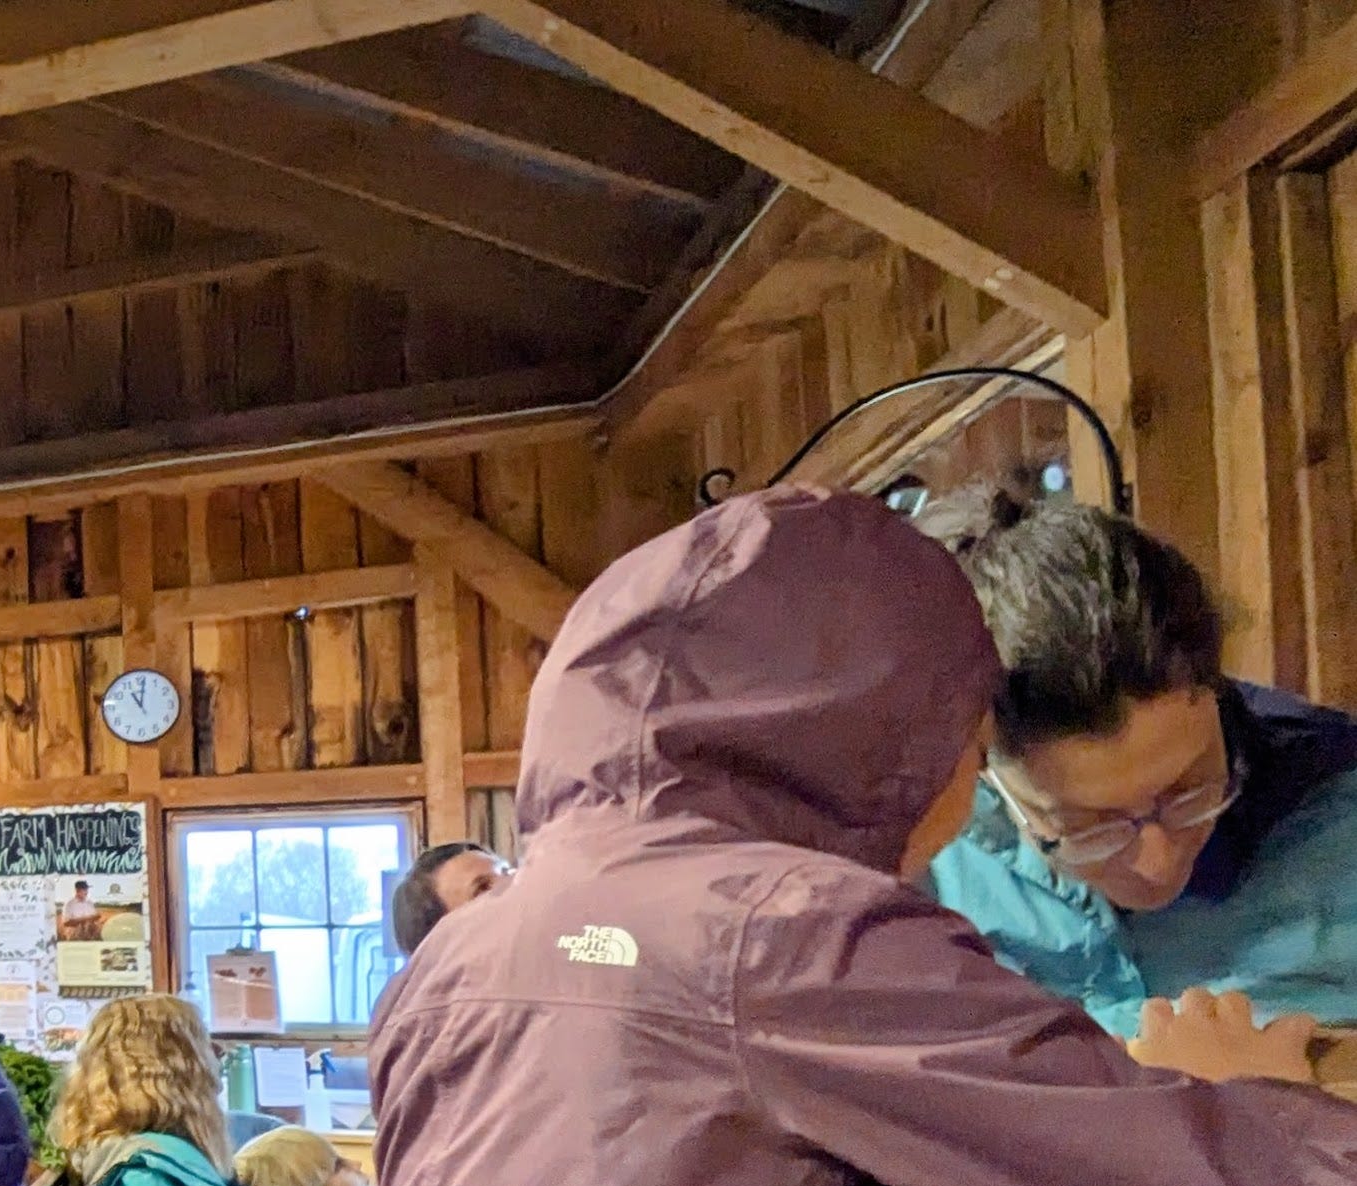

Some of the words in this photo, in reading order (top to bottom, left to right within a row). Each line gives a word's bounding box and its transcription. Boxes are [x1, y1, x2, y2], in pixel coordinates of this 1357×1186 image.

[0, 815, 48, 850] FARM
[55, 812, 142, 851] HAPPENINGS
[584, 925, 613, 939] THE
[557, 936, 609, 951] NORTH
[569, 951, 608, 962] FACE
